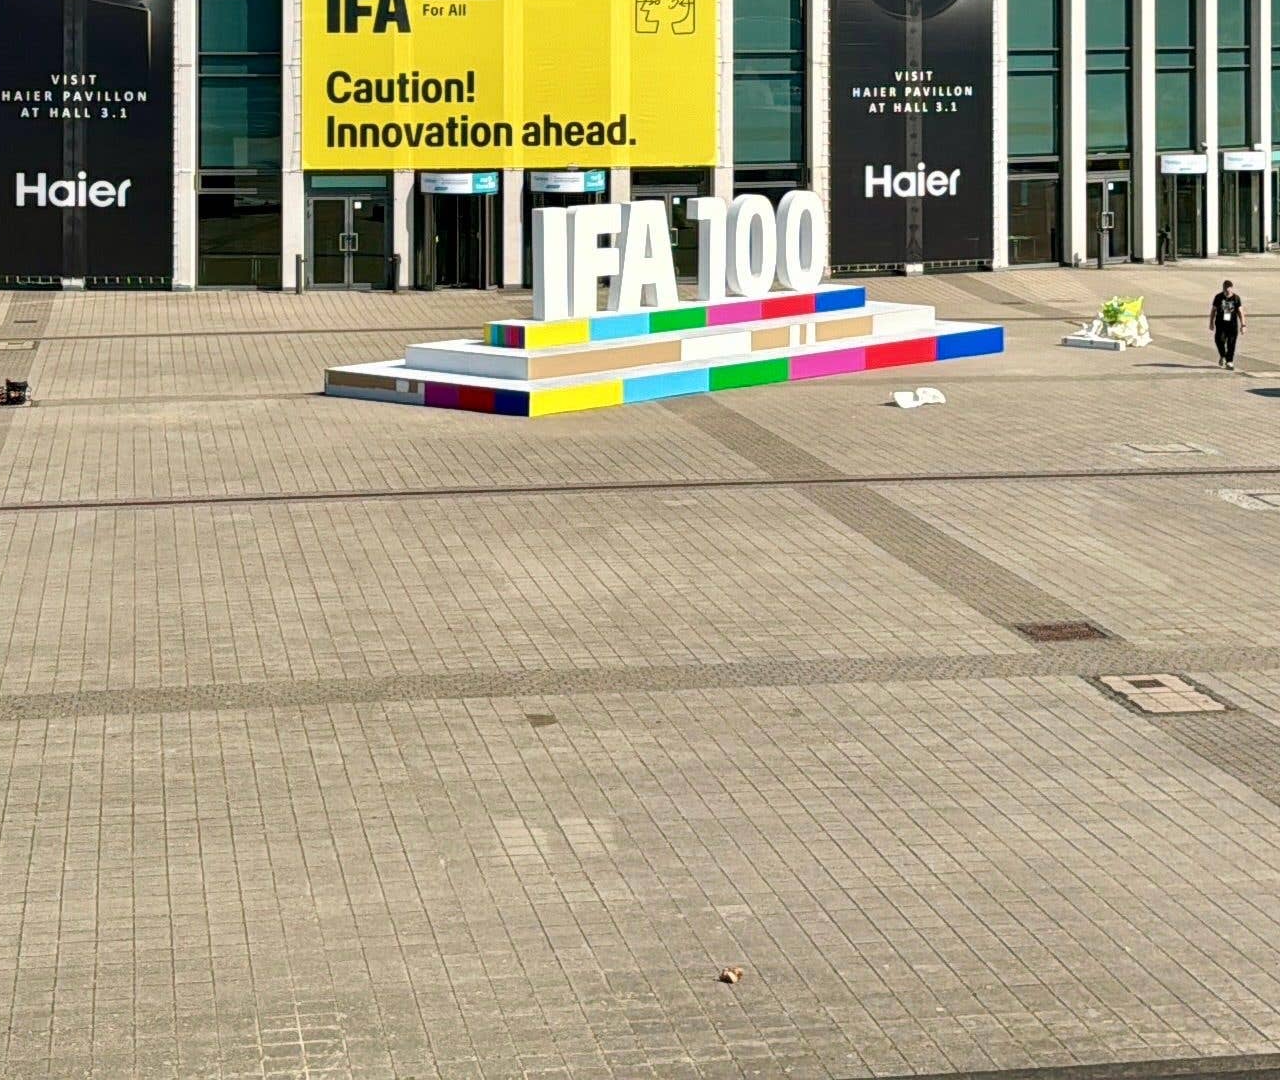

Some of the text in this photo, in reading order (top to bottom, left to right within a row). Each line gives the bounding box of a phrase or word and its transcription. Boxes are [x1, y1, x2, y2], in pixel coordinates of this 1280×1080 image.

[422, 2, 467, 17] For All
[51, 74, 97, 85] VISIT
[895, 71, 934, 82] VISIT
[326, 70, 476, 104] Caution!
[852, 86, 973, 98] HAIER PAVILLON
[1, 91, 148, 102] HAIER PAVILLON
[20, 107, 128, 118] AT HALL 3.1
[869, 101, 958, 113] AT HALL 3.1
[326, 114, 637, 148] Innovation ahead.
[864, 162, 961, 198] Haier
[15, 171, 132, 207] Haier
[532, 190, 825, 321] IFA 100
